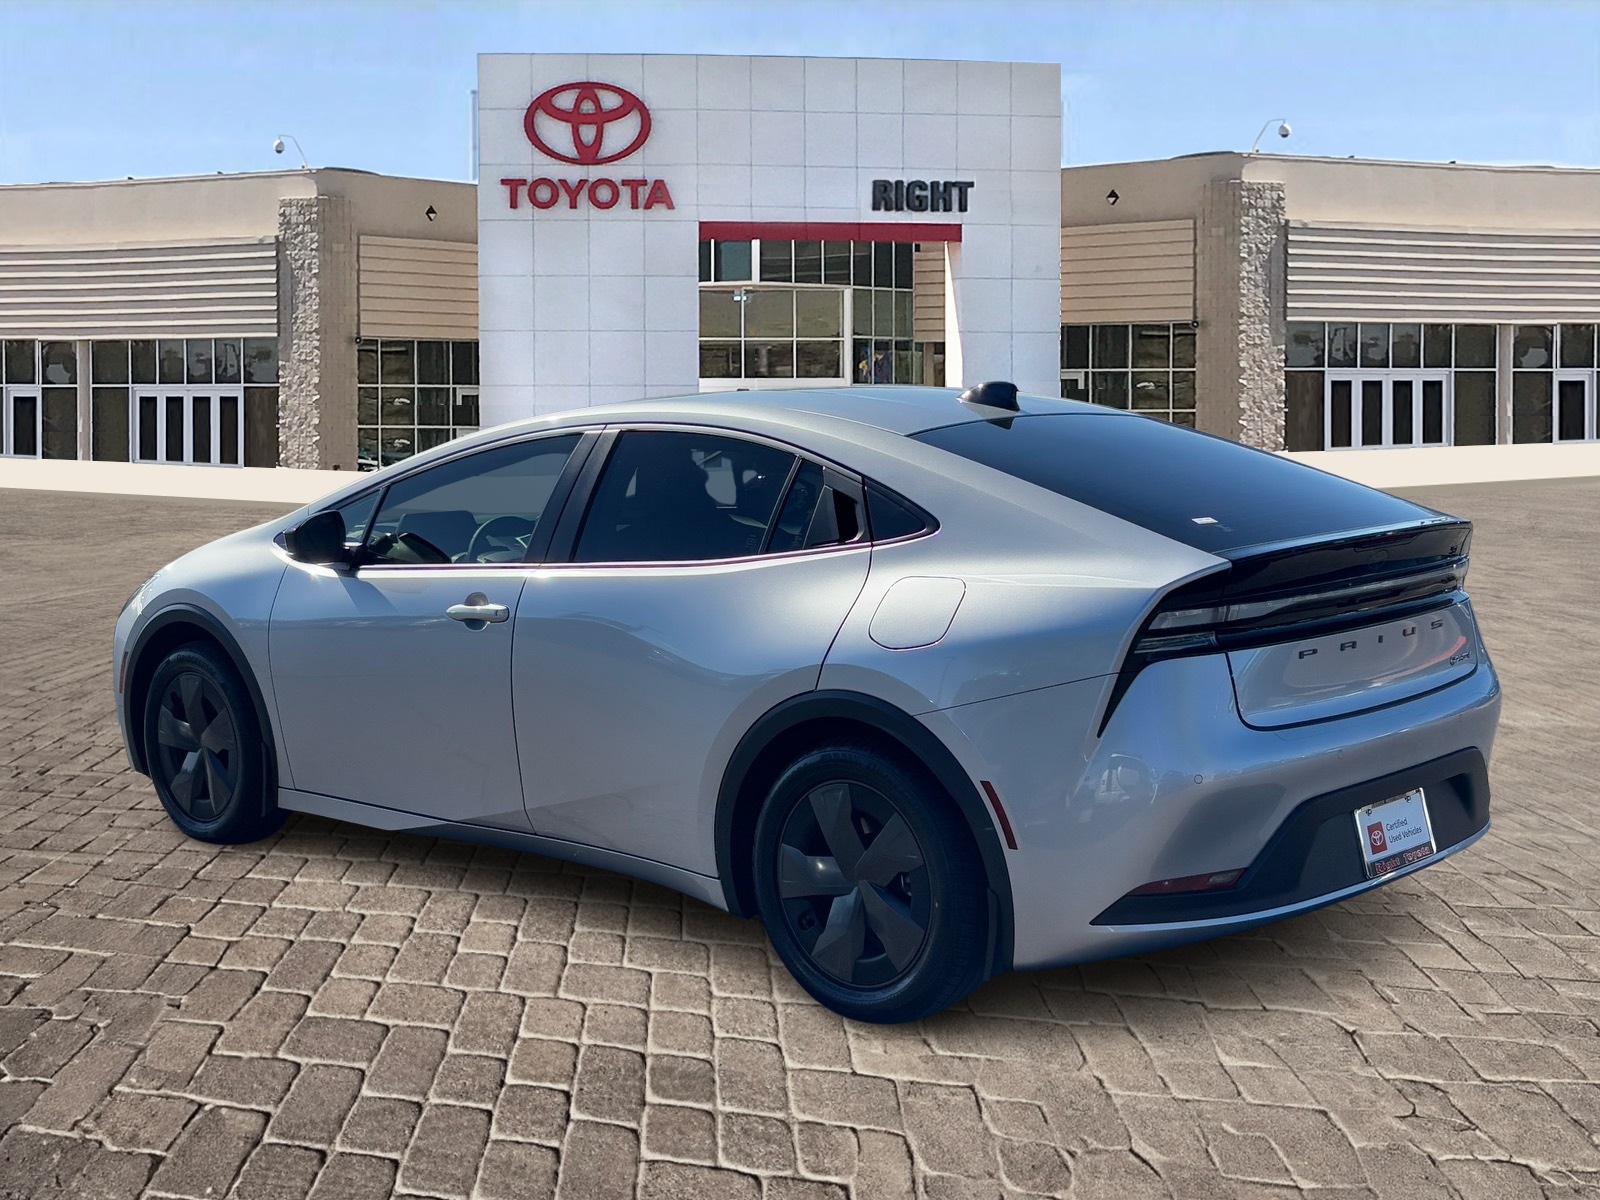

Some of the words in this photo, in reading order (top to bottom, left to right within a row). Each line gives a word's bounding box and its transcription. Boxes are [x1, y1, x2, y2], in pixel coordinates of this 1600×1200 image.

[501, 178, 674, 210] TOYOTA
[871, 179, 975, 213] RIGHT
[1298, 619, 1443, 659] PRIUS
[1386, 817, 1408, 831] Certified
[1389, 831, 1403, 844] Used
[1402, 826, 1422, 840] Vehicles
